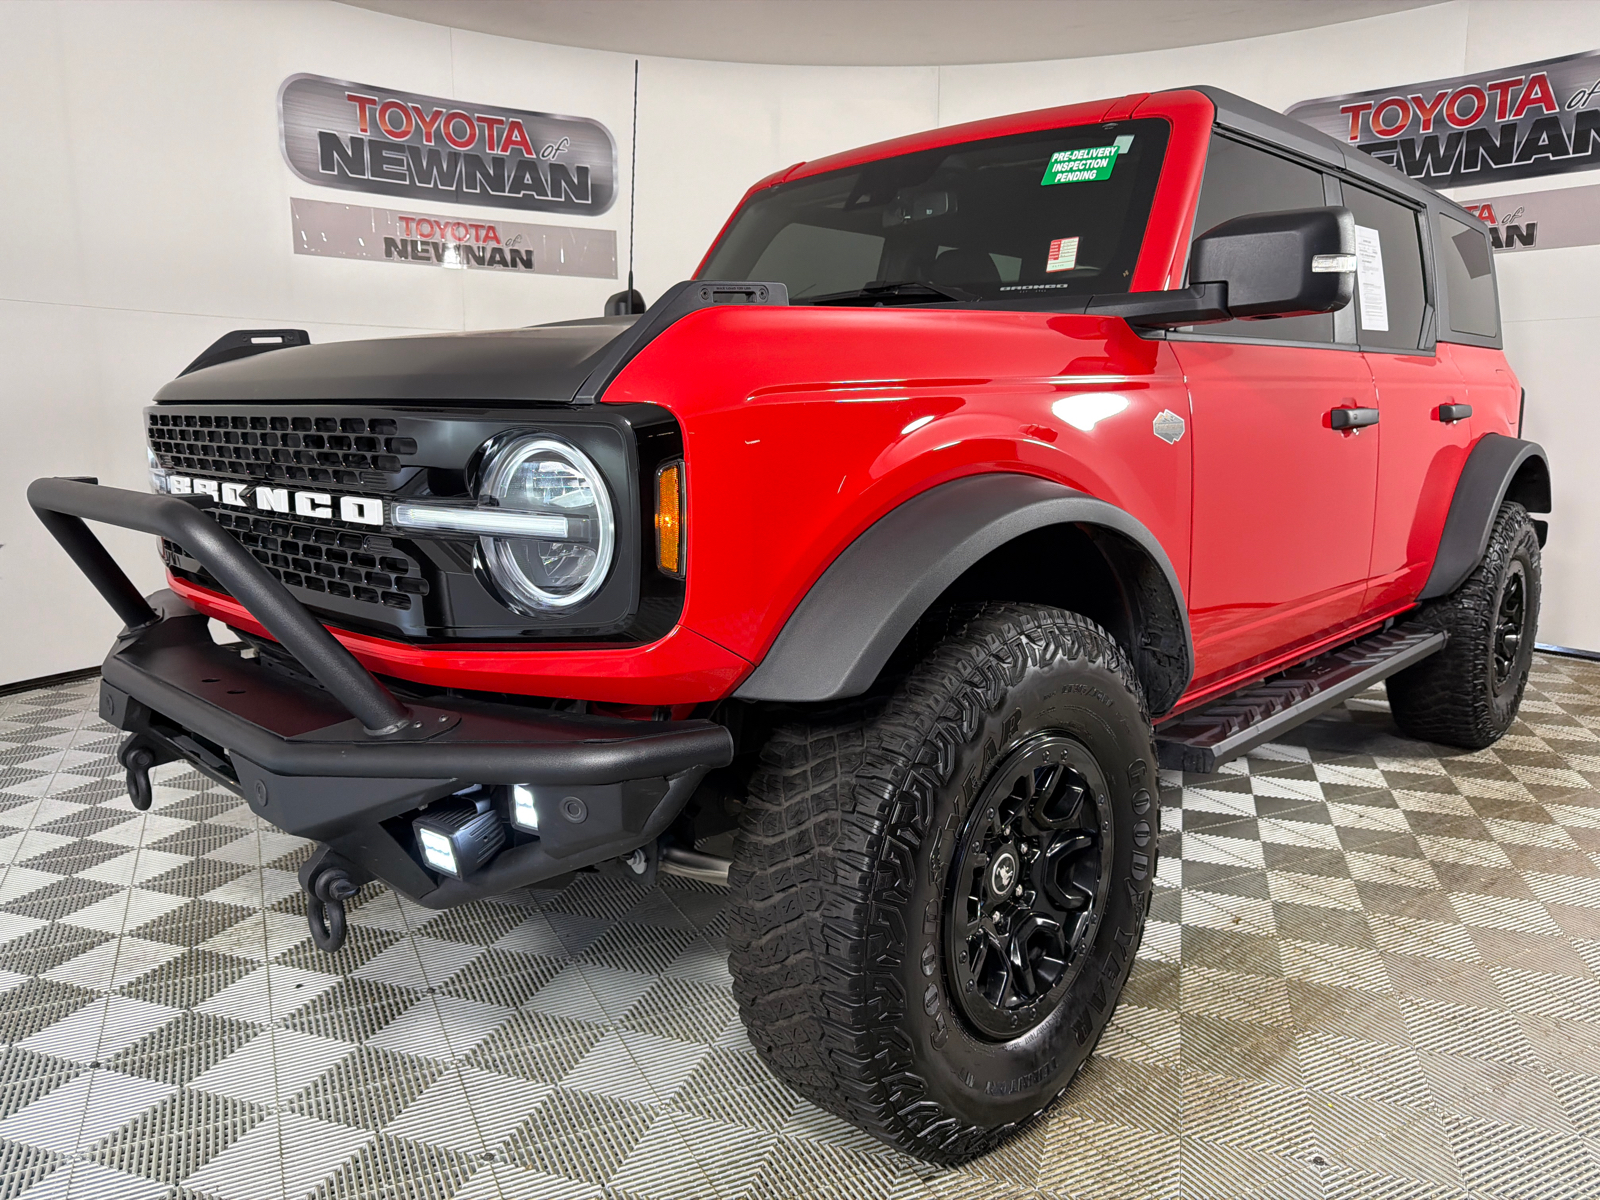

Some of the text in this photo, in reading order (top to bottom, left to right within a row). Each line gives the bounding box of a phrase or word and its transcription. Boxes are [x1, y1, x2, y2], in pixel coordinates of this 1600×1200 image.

[1340, 71, 1559, 142] TOYOTA
[345, 92, 570, 160] TOYOTA of
[317, 130, 592, 204] NEWNAN
[1051, 147, 1118, 162] PRE-DELIVERY
[1051, 158, 1109, 173] INSPECTION
[1054, 170, 1097, 183] PENDING
[398, 215, 522, 248] TOYOTA of
[1501, 205, 1524, 225] of
[169, 475, 384, 526] BRONCO
